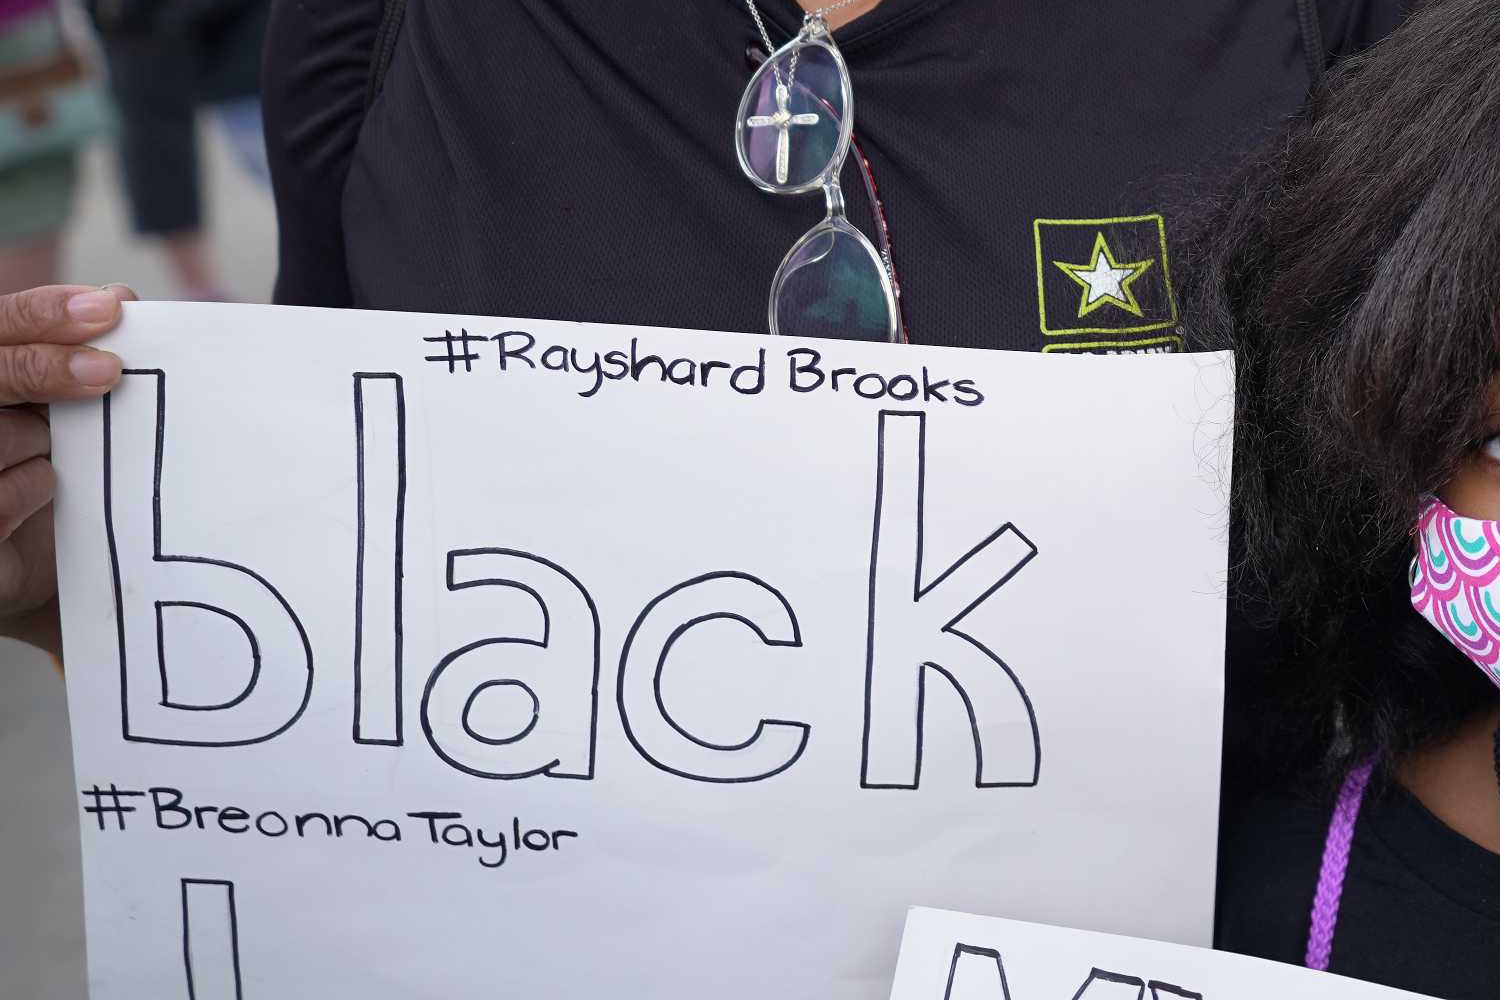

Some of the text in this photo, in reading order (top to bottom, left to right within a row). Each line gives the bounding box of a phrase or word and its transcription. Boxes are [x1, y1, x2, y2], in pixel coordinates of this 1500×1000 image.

[422, 327, 985, 407] #Rayshard Brooks
[104, 369, 1042, 791] black
